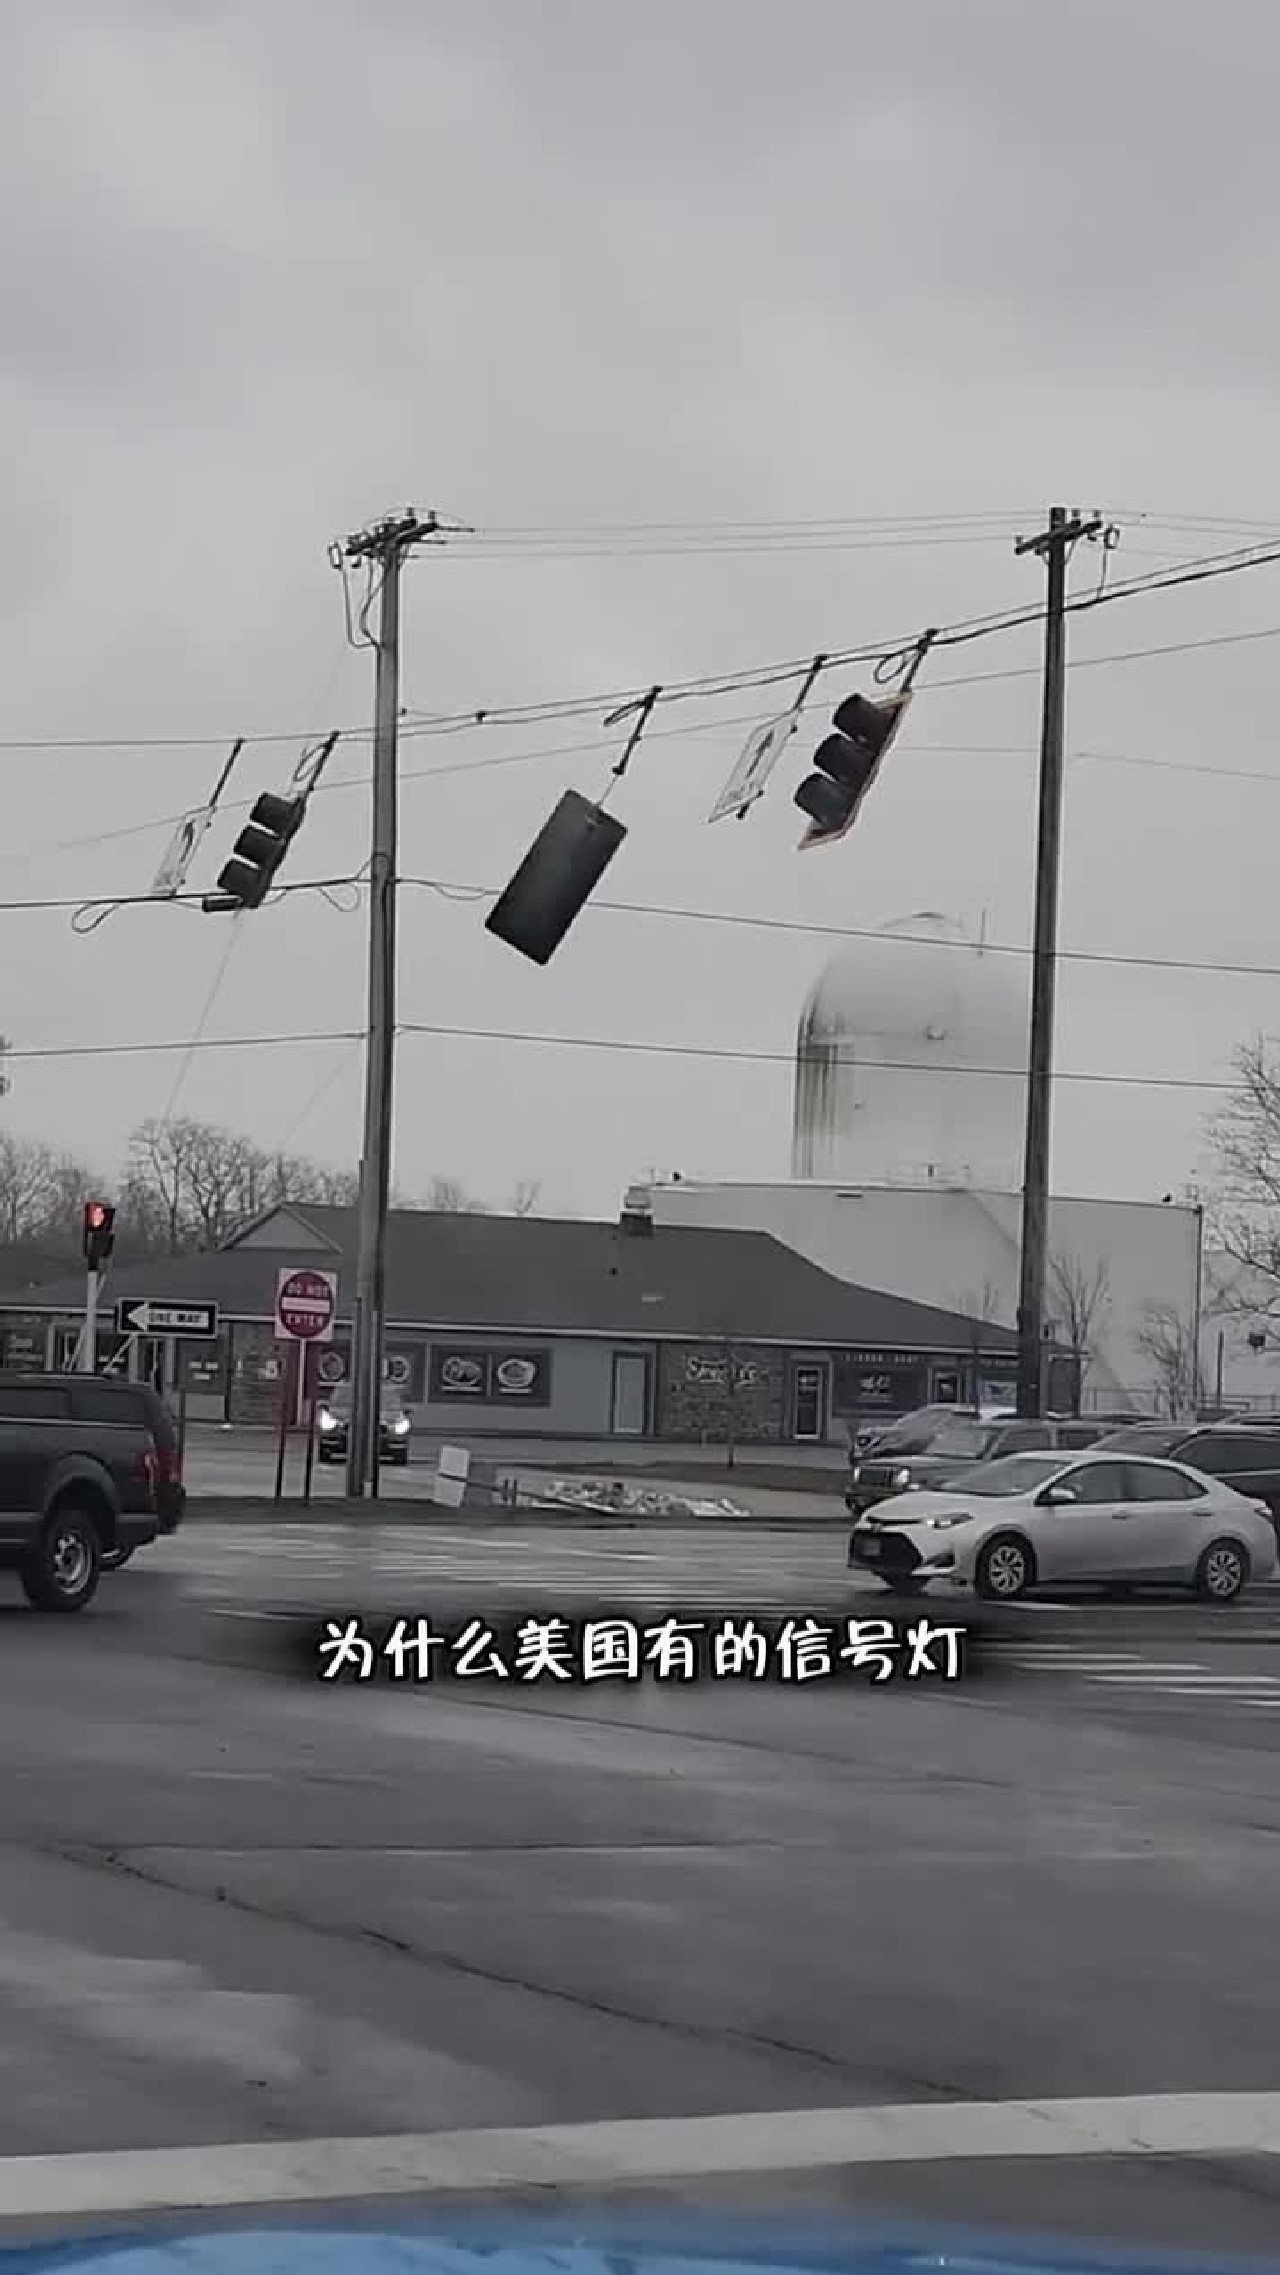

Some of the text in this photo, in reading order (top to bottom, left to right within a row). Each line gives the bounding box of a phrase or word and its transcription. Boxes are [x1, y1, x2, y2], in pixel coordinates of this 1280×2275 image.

[287, 1282, 302, 1294] DO
[149, 1311, 202, 1323] ONE WAY
[286, 1313, 325, 1326] ENTER
